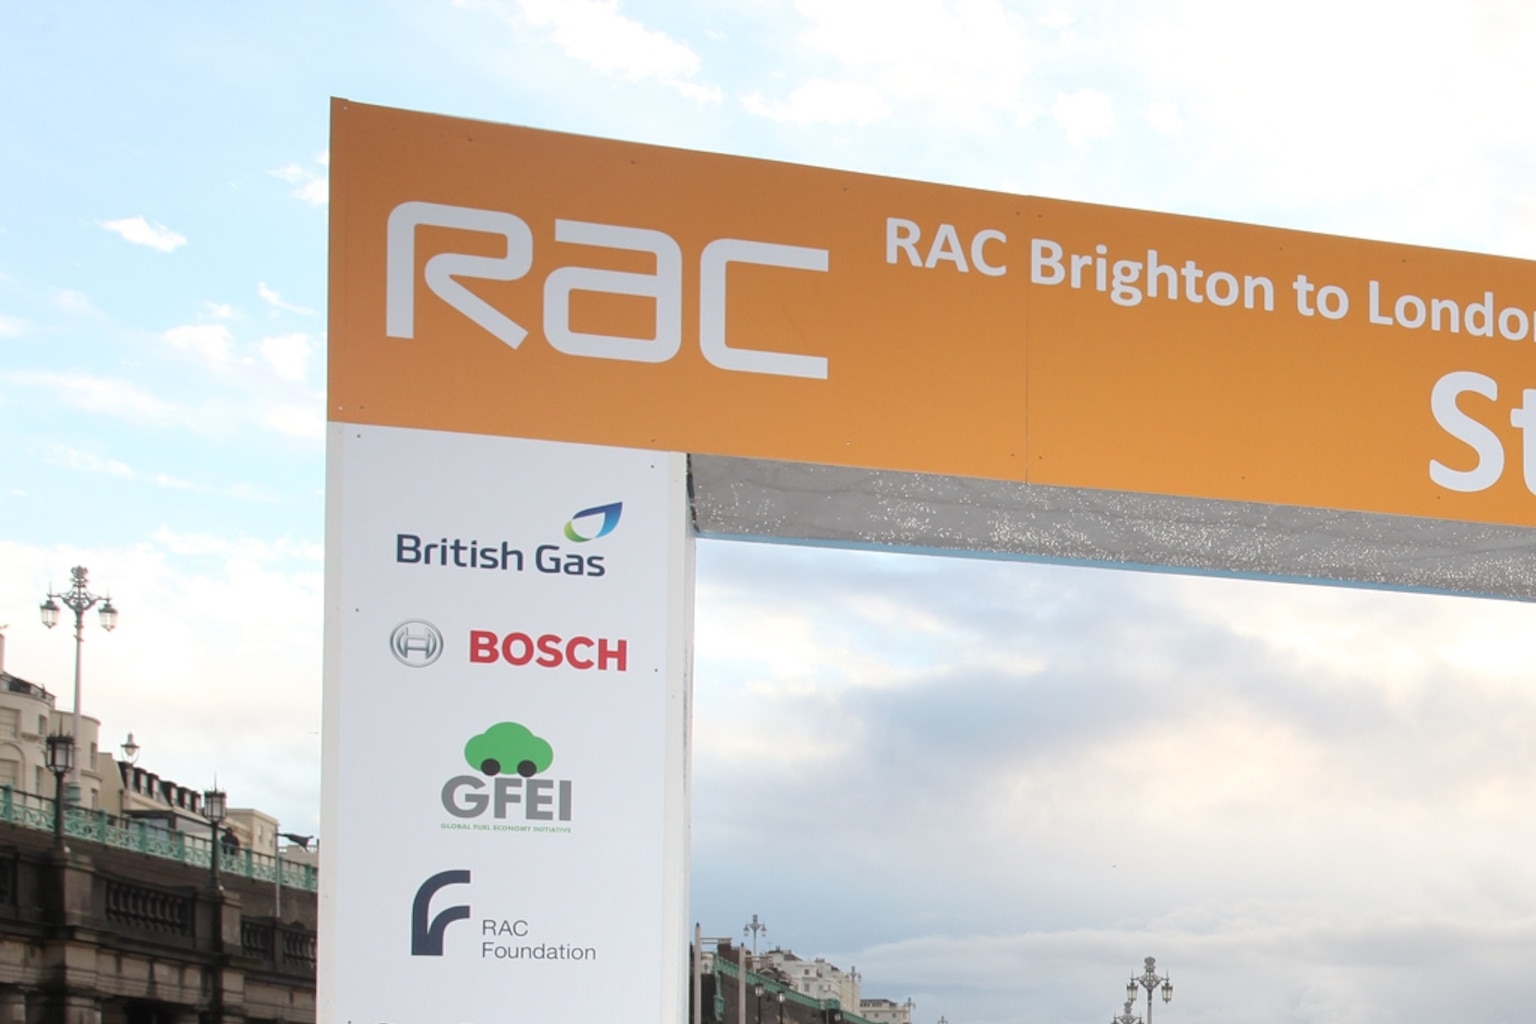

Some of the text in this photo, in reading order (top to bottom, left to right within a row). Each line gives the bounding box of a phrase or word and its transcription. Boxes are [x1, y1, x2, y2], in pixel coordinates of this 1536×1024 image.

[884, 217, 1007, 277] RAC
[1030, 237, 1274, 311] Brighton
[1292, 275, 1348, 319] to
[396, 533, 606, 577] British Gas
[469, 630, 628, 672] BOSCH
[441, 774, 572, 822] GFEI
[440, 822, 471, 831] GLOBAL
[473, 823, 491, 831] FUEL
[493, 824, 531, 832] ECONOMY
[482, 919, 528, 937] RAC
[482, 942, 597, 960] Foundation
